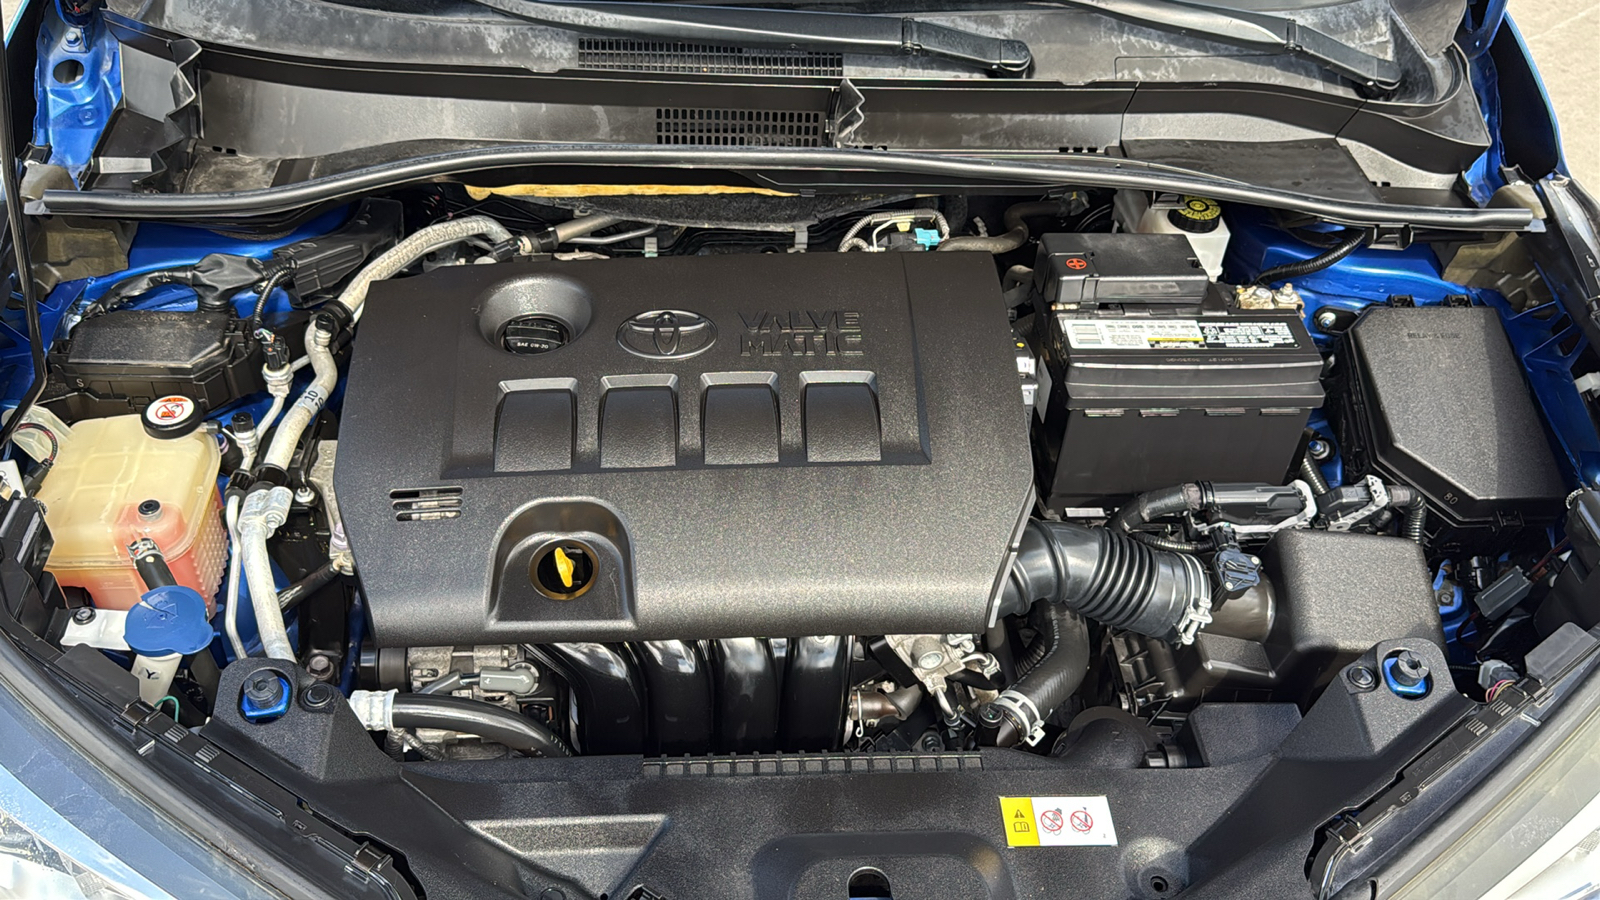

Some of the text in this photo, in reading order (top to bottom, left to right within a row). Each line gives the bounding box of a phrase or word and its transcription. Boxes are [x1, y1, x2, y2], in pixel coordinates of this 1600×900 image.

[738, 311, 861, 333] VALVE
[741, 333, 863, 356] MATIC
[304, 390, 319, 402] 10
[1443, 492, 1459, 504] 80
